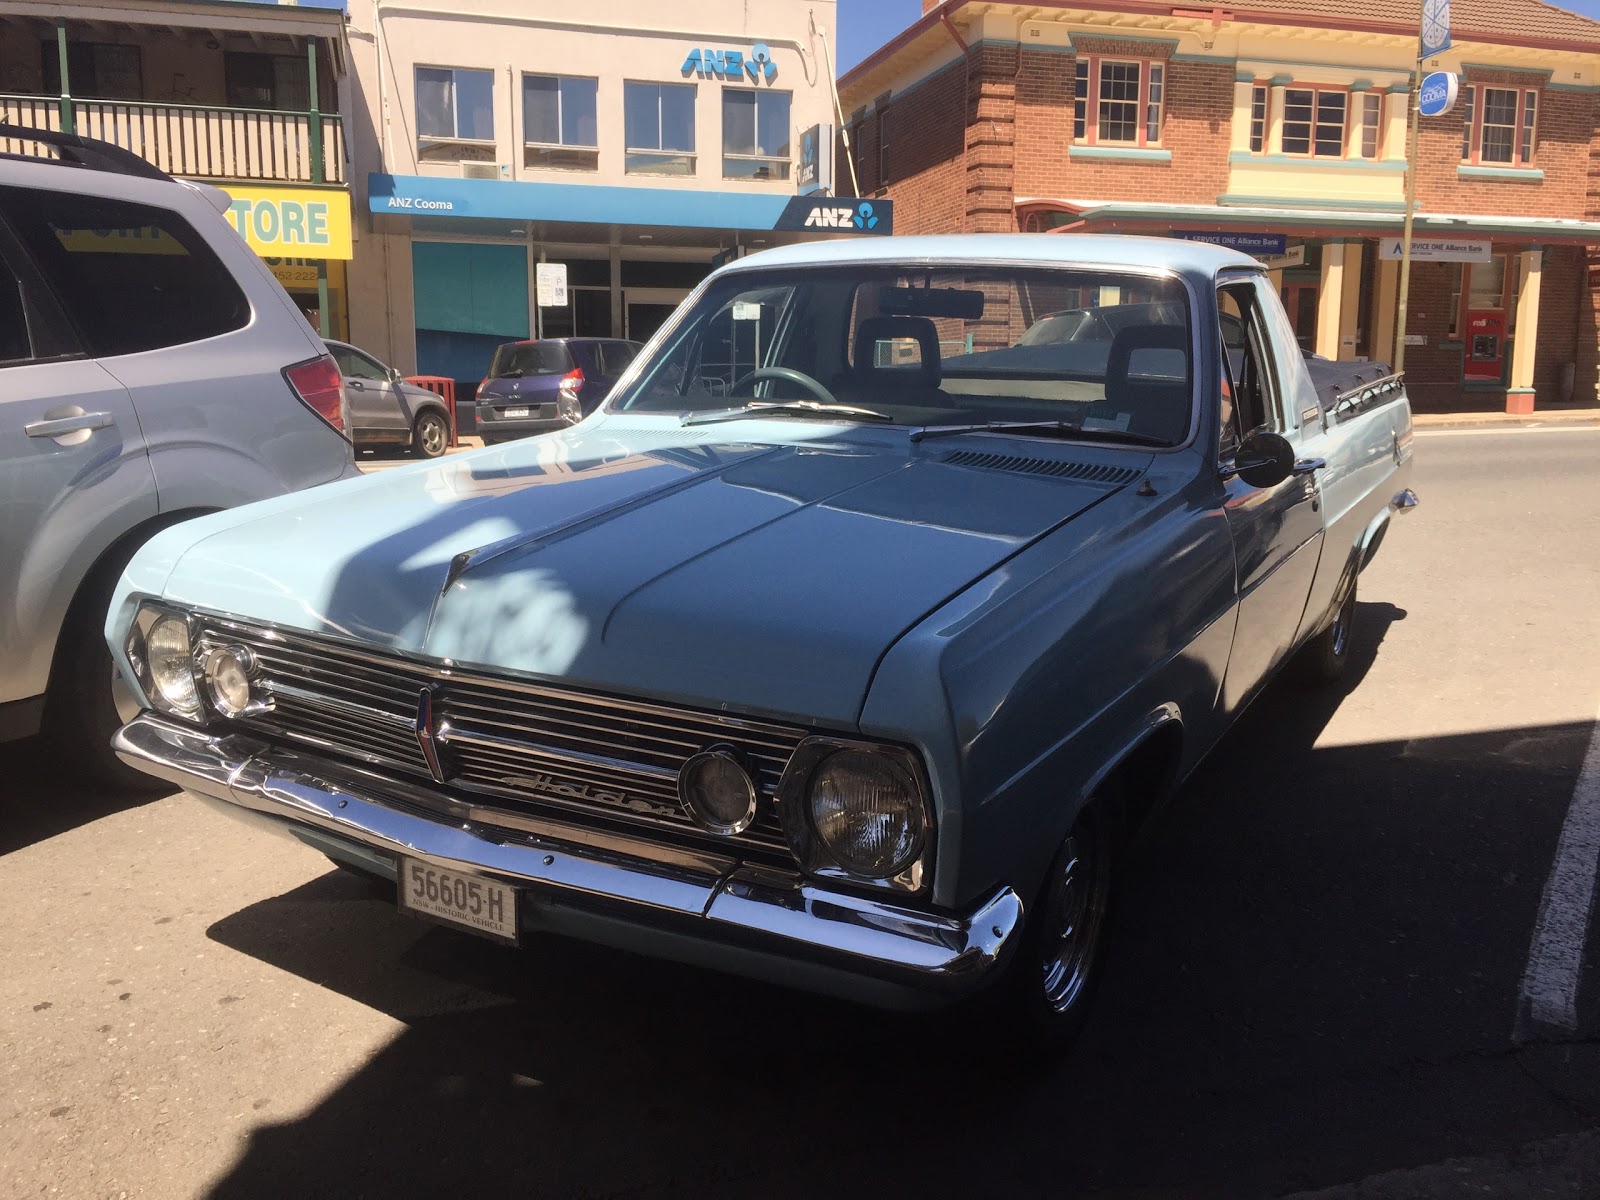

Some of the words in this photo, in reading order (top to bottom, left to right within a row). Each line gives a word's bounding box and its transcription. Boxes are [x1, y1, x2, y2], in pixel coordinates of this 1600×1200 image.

[681, 48, 743, 75] ANZ
[802, 165, 814, 183] ANZ
[388, 197, 412, 208] ANZ
[414, 198, 453, 210] Cooma
[228, 198, 330, 245] TORE
[804, 207, 853, 228] ANZ
[1192, 235, 1220, 244] SERVICE
[1222, 236, 1236, 244] ONE
[1237, 237, 1261, 246] Alliance
[1263, 238, 1279, 246] Bank
[1410, 242, 1429, 250] ERVICE
[1431, 243, 1444, 251] ONE
[1445, 244, 1467, 252] Alliance
[1468, 244, 1483, 252] Bank
[294, 271, 319, 281] 222
[500, 774, 677, 817] Holden
[413, 898, 429, 909] NSW
[435, 904, 469, 921] HISTORIC
[471, 917, 504, 932] VEHICLE
